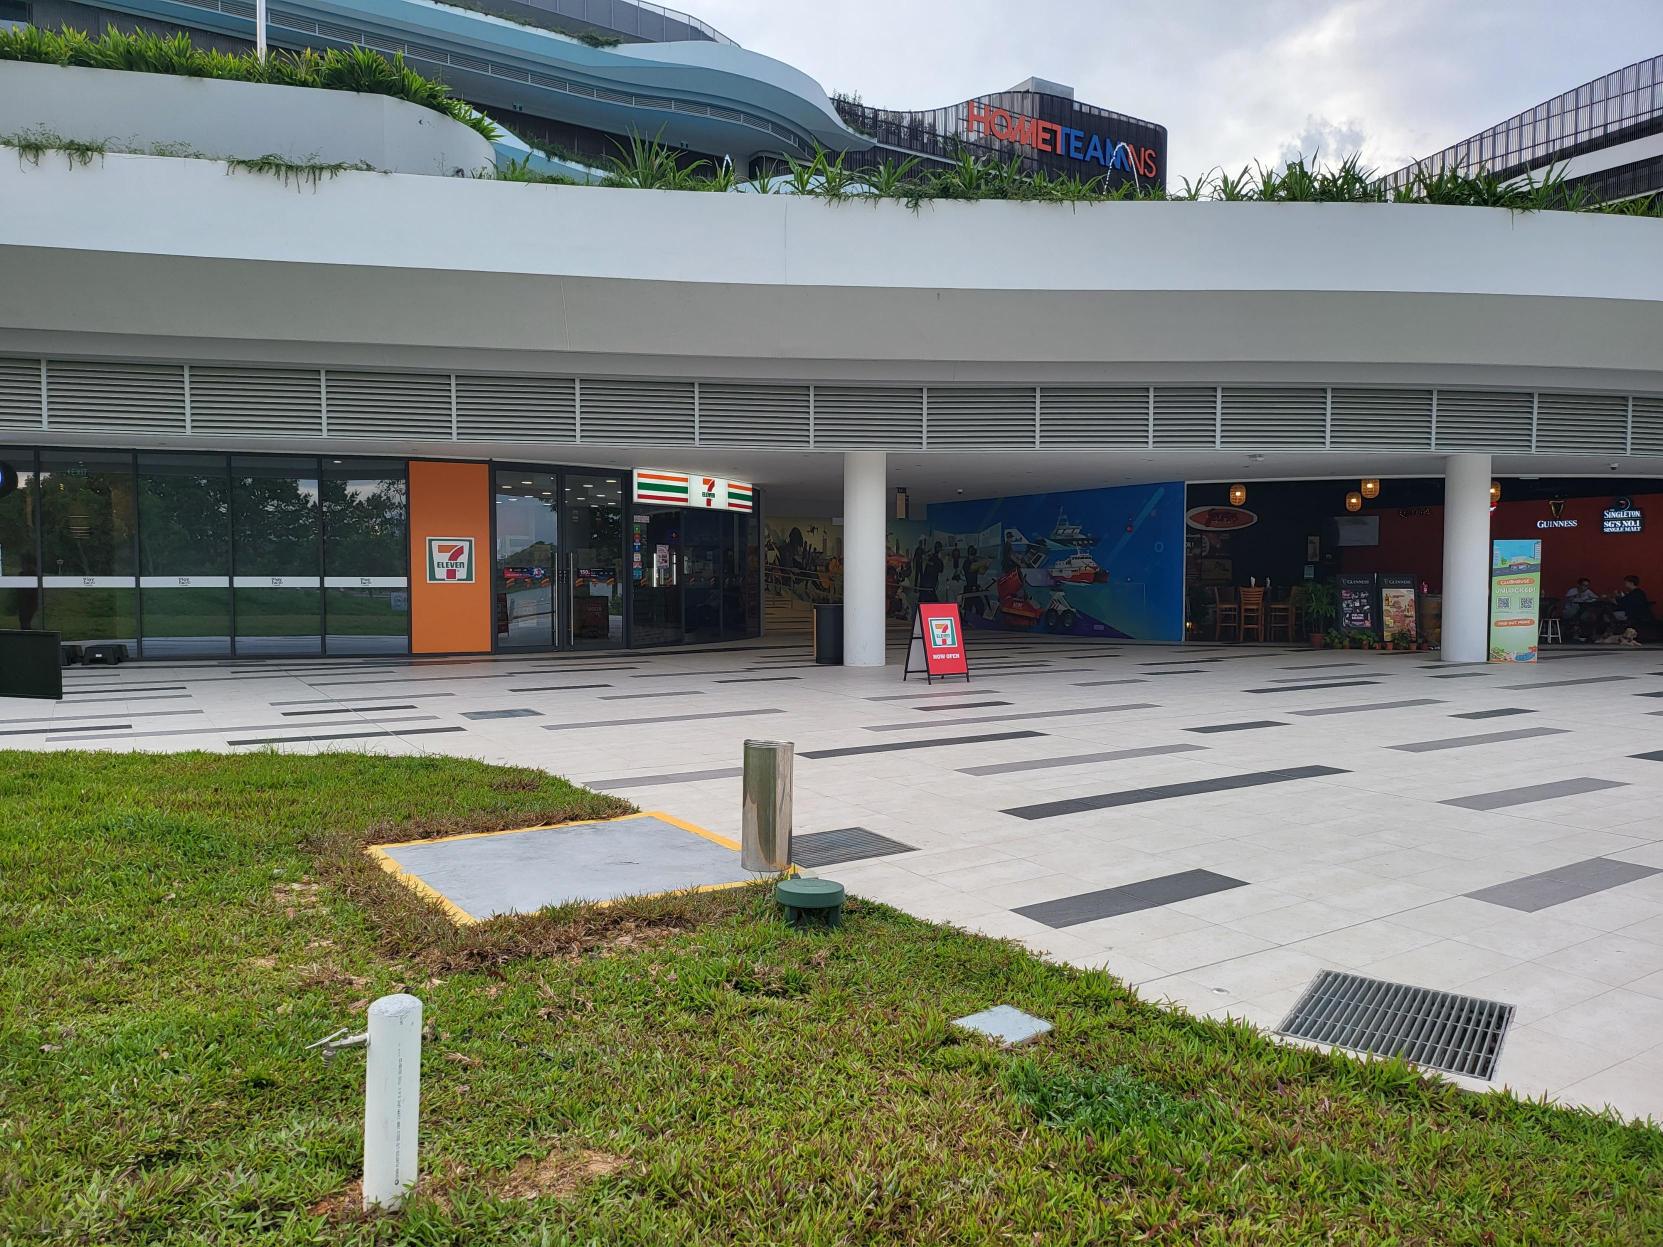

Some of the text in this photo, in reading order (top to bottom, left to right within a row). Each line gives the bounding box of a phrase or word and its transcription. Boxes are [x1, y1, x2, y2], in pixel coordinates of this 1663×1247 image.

[703, 478, 715, 506] 7
[1537, 520, 1578, 528] GUINNESS
[1603, 510, 1641, 519] SINGLETON
[438, 544, 464, 580] 7
[935, 624, 948, 645] 7
